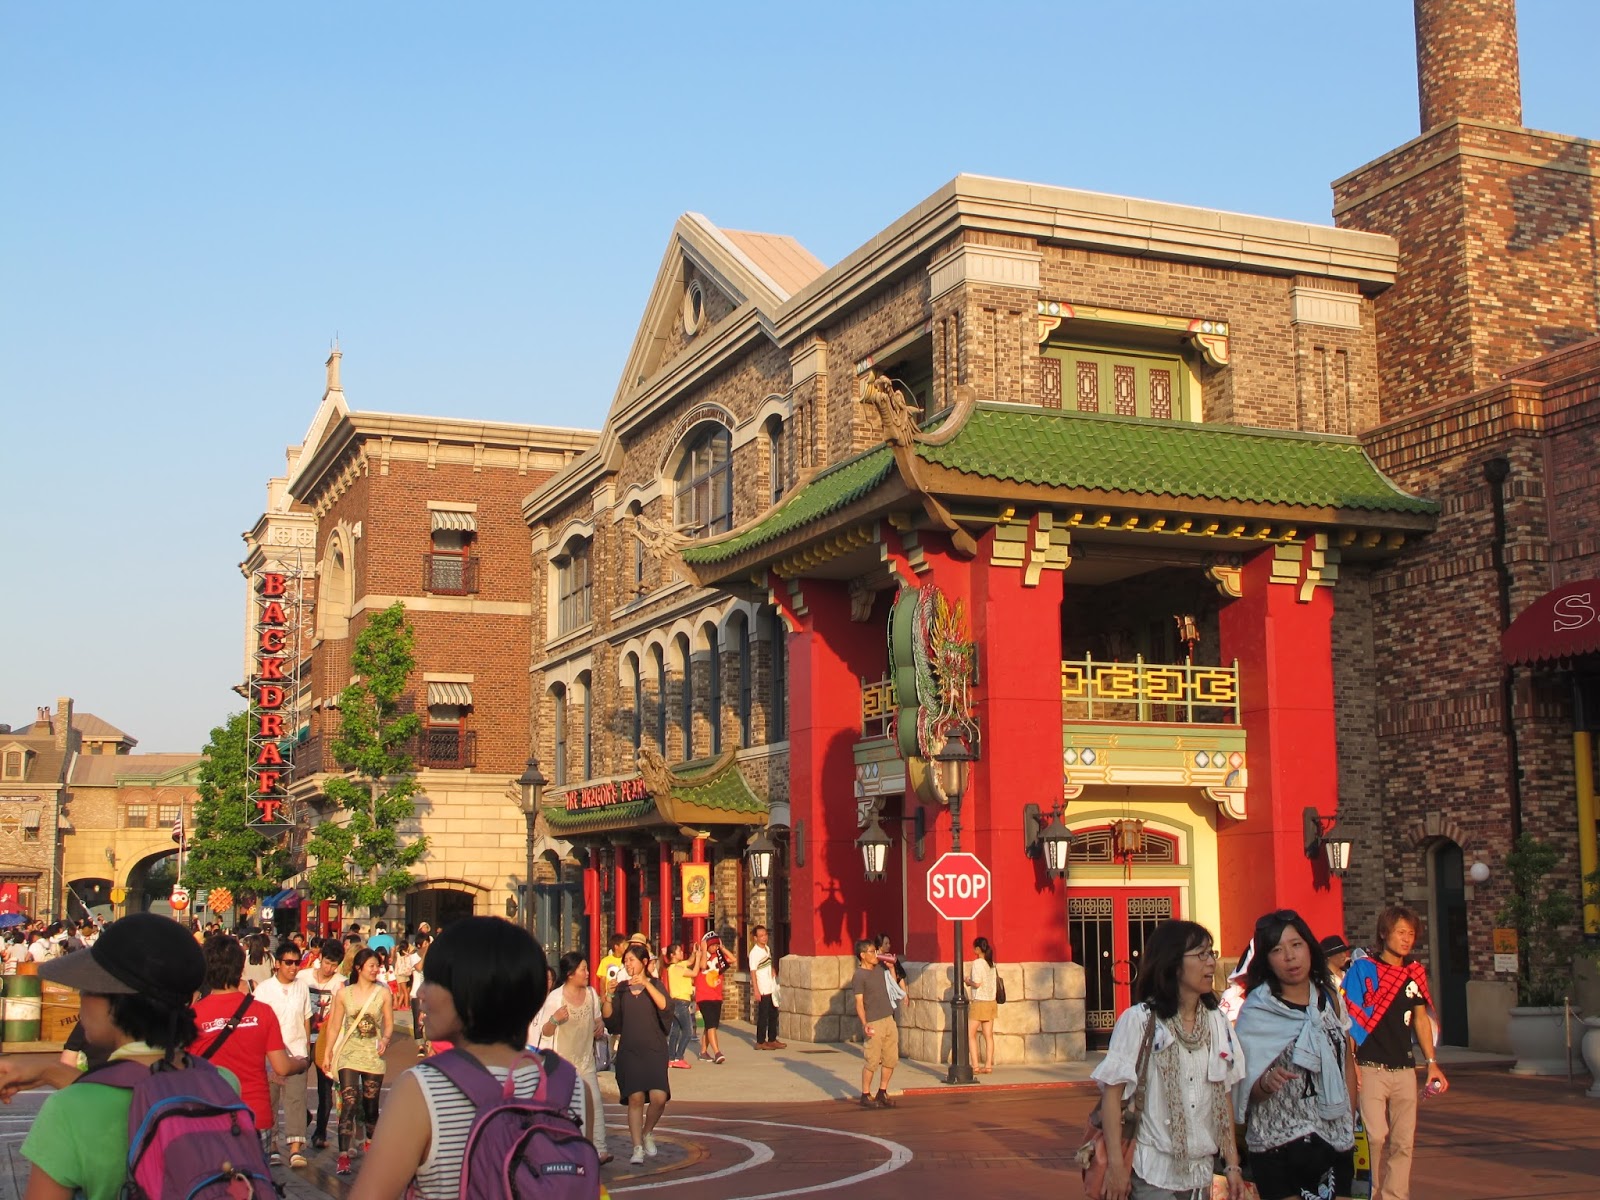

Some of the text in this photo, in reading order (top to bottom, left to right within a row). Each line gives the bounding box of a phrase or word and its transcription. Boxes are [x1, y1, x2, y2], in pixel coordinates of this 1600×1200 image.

[1553, 592, 1600, 632] S
[256, 573, 287, 822] BACKDRAFT
[932, 873, 986, 899] STOP
[546, 1164, 573, 1173] MILLET
